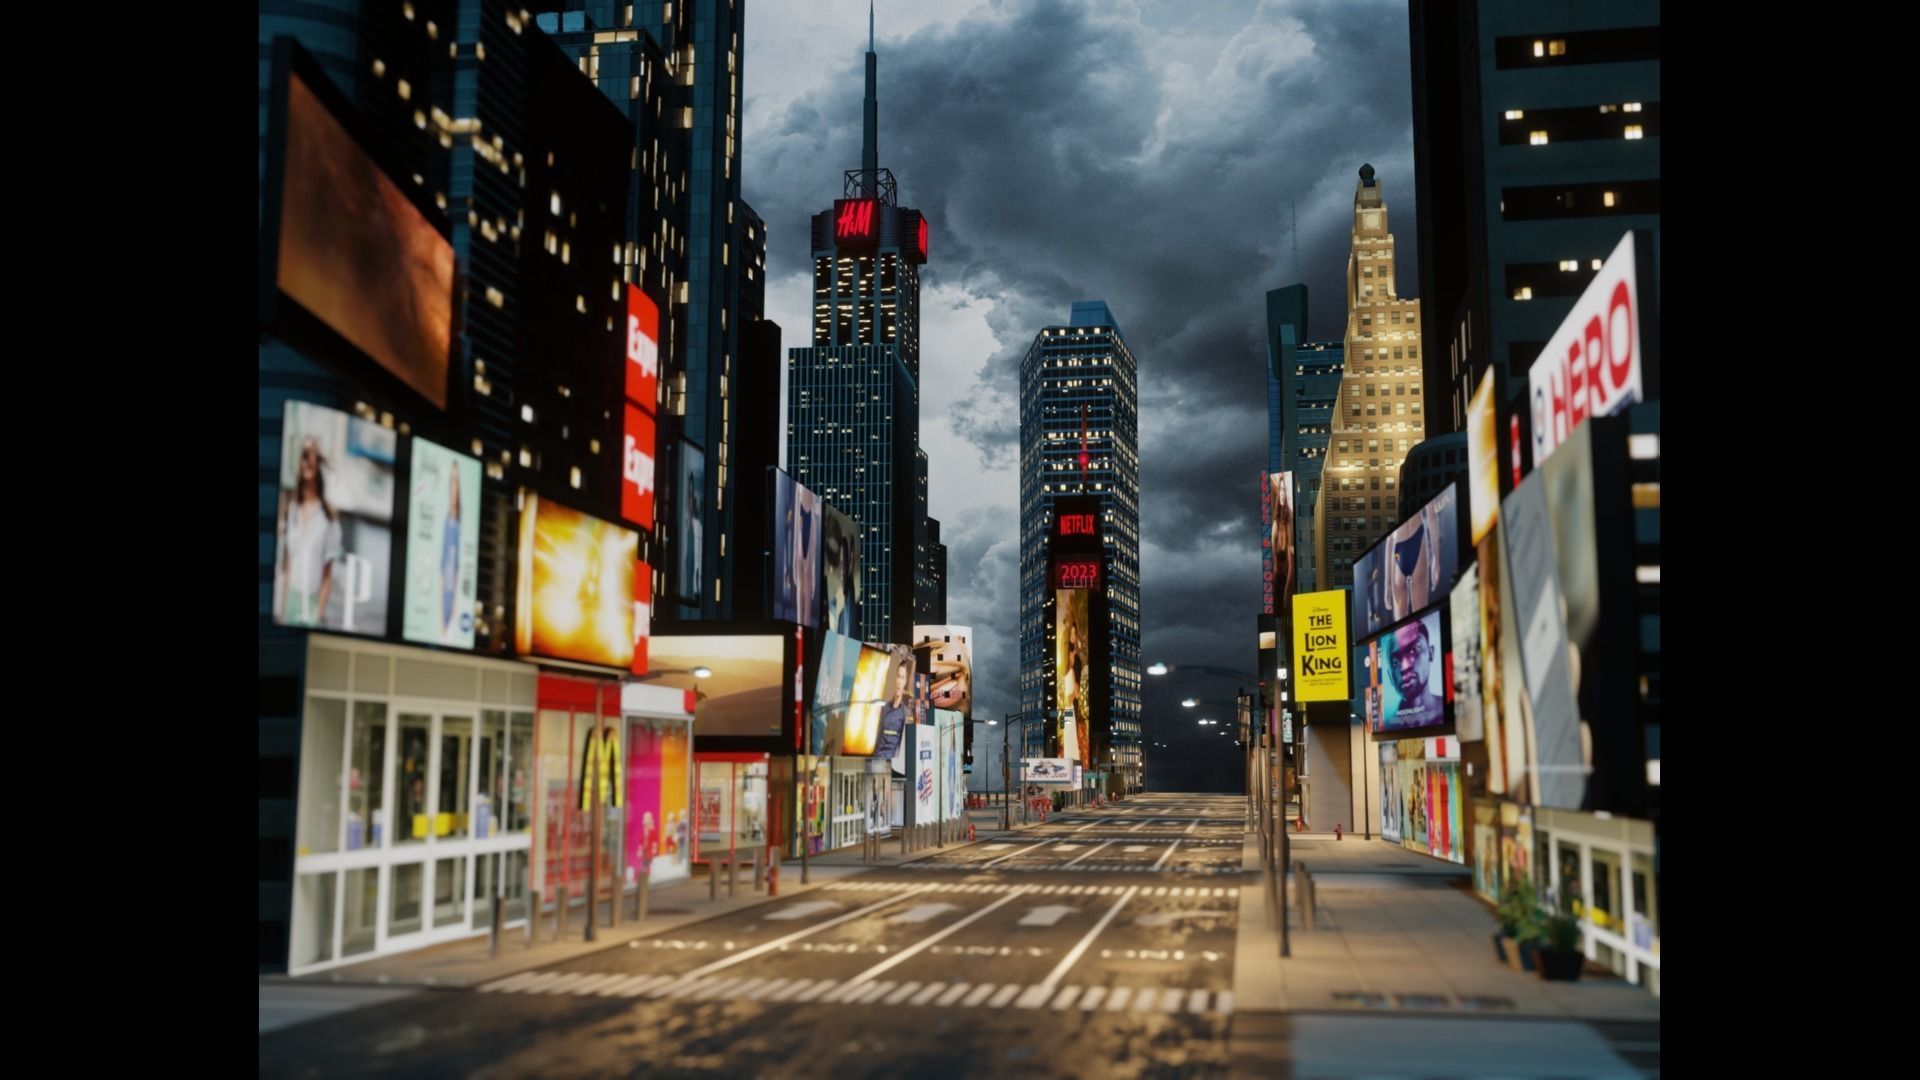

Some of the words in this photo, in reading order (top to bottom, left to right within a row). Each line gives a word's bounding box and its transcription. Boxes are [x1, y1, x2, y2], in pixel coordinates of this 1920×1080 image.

[1549, 280, 1632, 448] HERO
[1060, 514, 1095, 536] NETFLIX
[1062, 564, 1097, 580] 2023
[1308, 614, 1333, 627] THE
[1304, 633, 1337, 652] LION
[1302, 655, 1342, 677] KING
